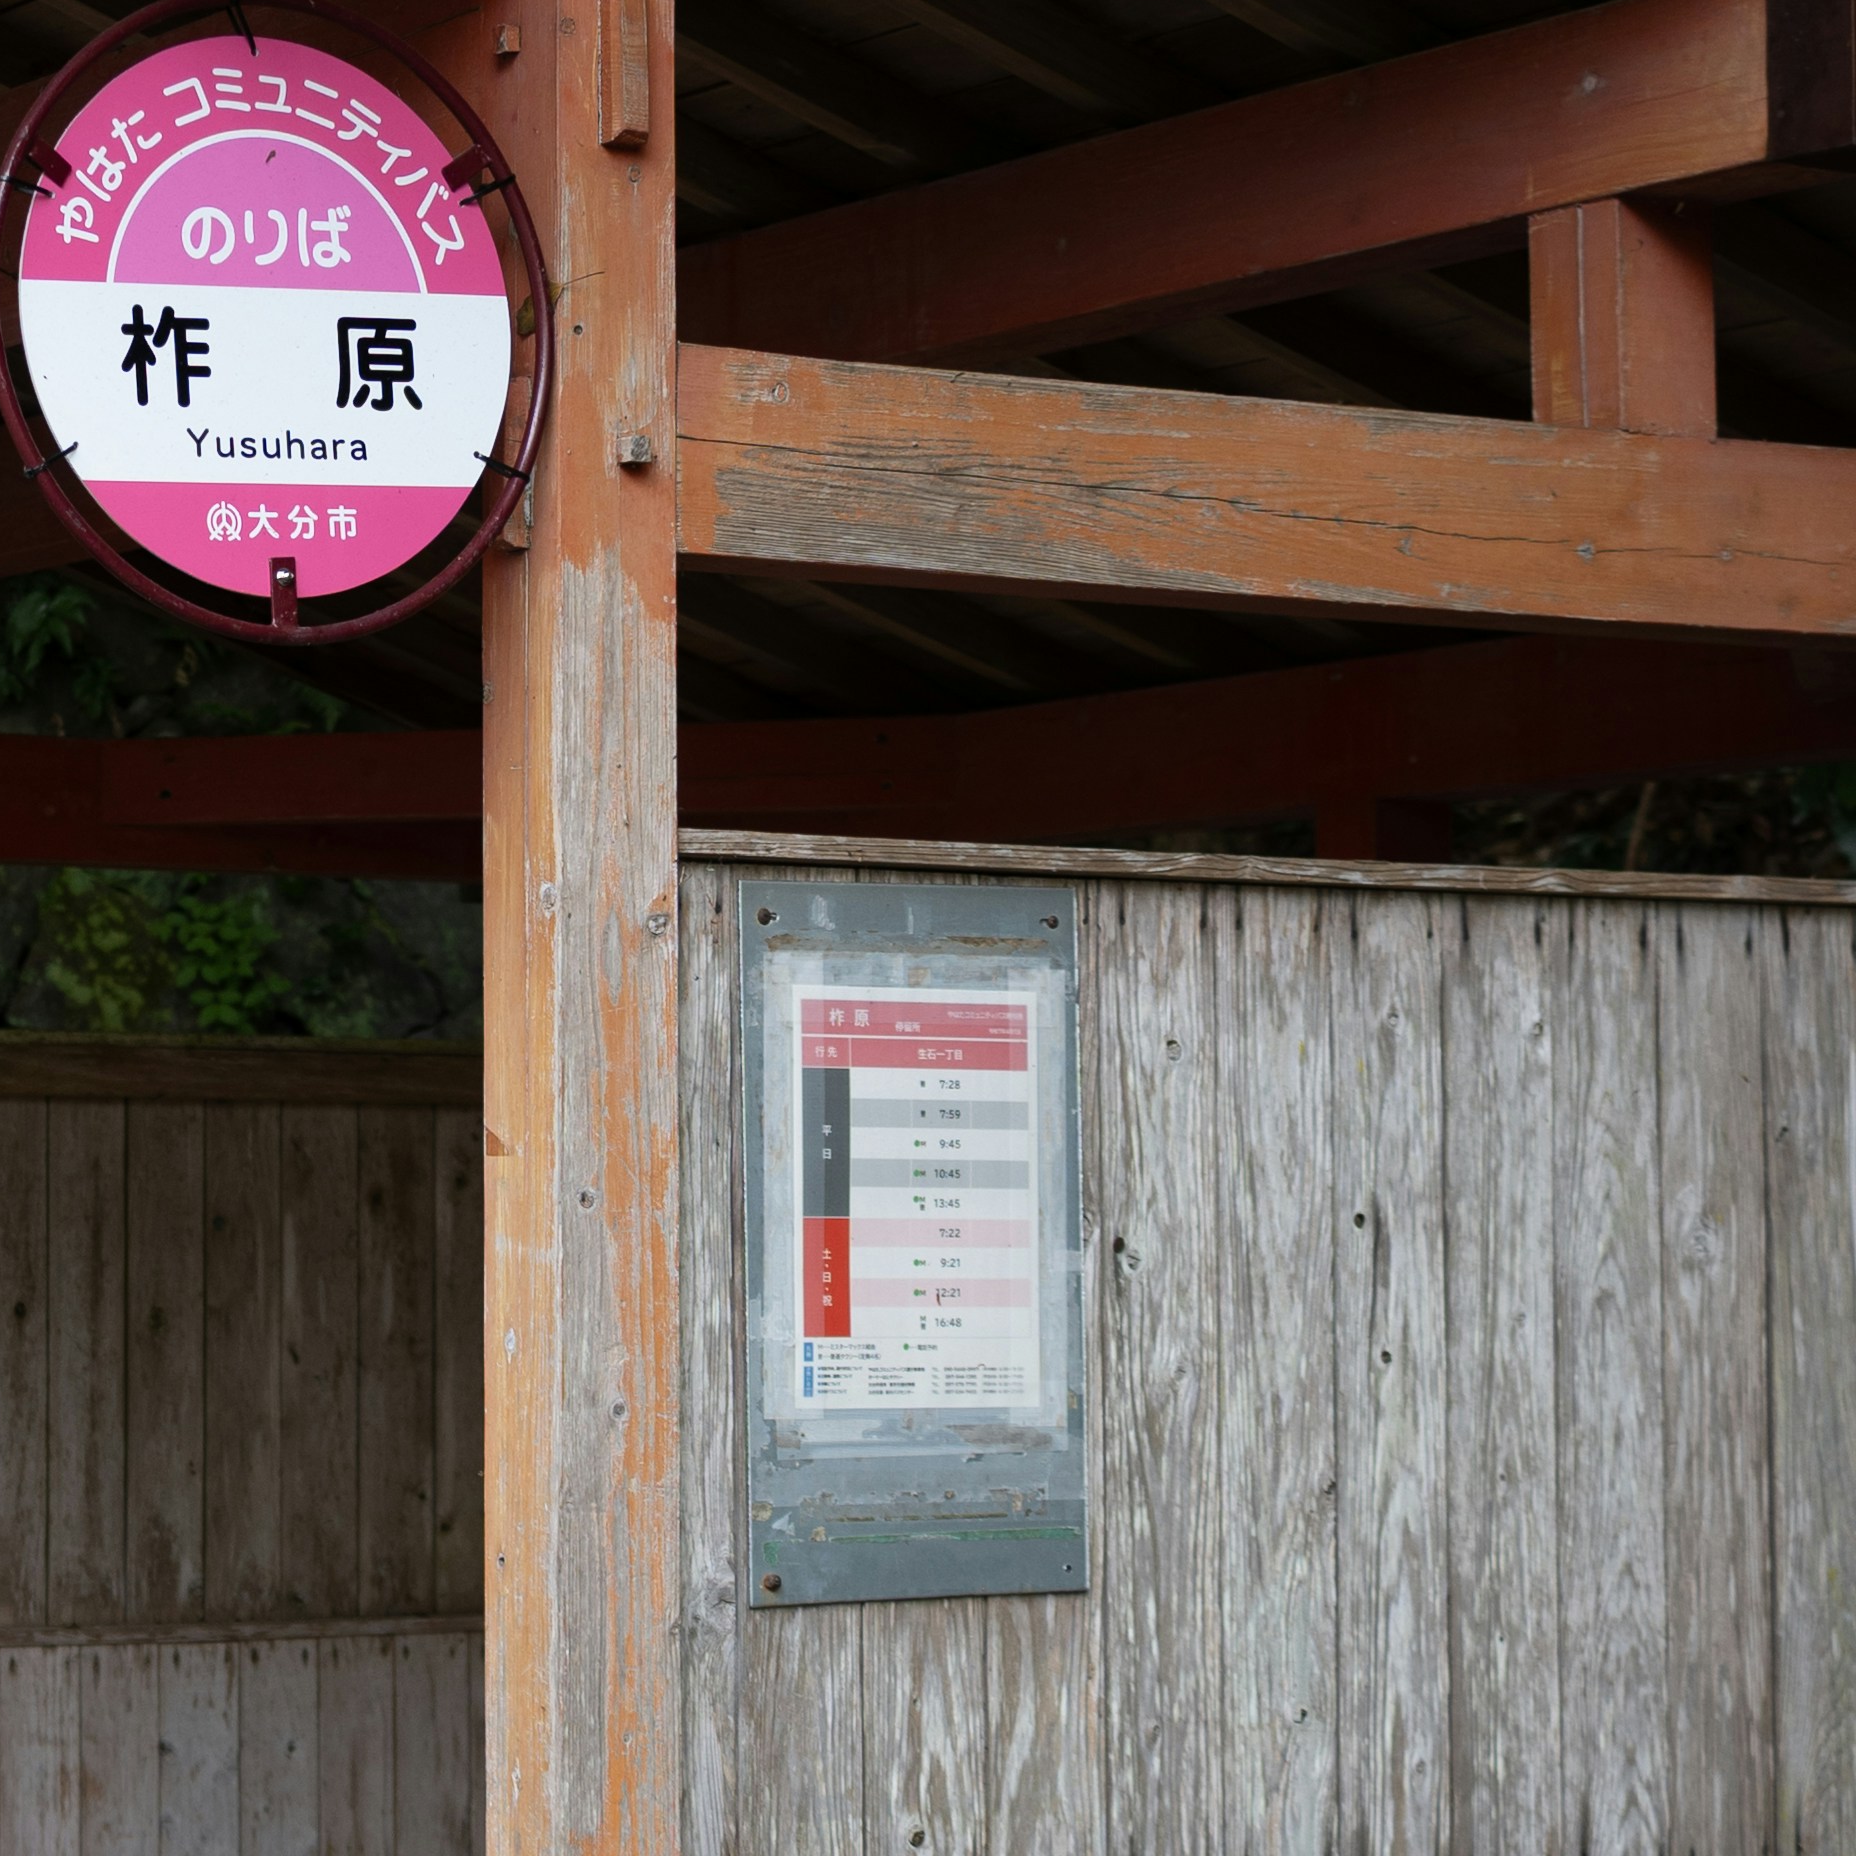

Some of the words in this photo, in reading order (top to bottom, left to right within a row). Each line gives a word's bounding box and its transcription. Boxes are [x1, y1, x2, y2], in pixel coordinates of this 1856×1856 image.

[55, 67, 465, 265] やはたコミュニティバス
[181, 205, 352, 268] のりば
[120, 304, 423, 412] 柞原
[185, 427, 369, 461] Yusuhara
[247, 504, 358, 541] 大分市
[829, 1008, 870, 1027] 柞原
[815, 1046, 839, 1058] 行先
[918, 1049, 963, 1061] 生石一丁目
[939, 1080, 961, 1089] 7:28
[939, 1109, 961, 1119] 7:59
[822, 1124, 832, 1160] 平日
[939, 1139, 961, 1149] 9:45
[934, 1169, 961, 1179] 10:45
[934, 1199, 960, 1208] 13:45
[939, 1228, 961, 1238] 7:22
[940, 1258, 961, 1267] 9:21
[936, 1288, 961, 1298] 12:21
[934, 1318, 962, 1327] 16:48
